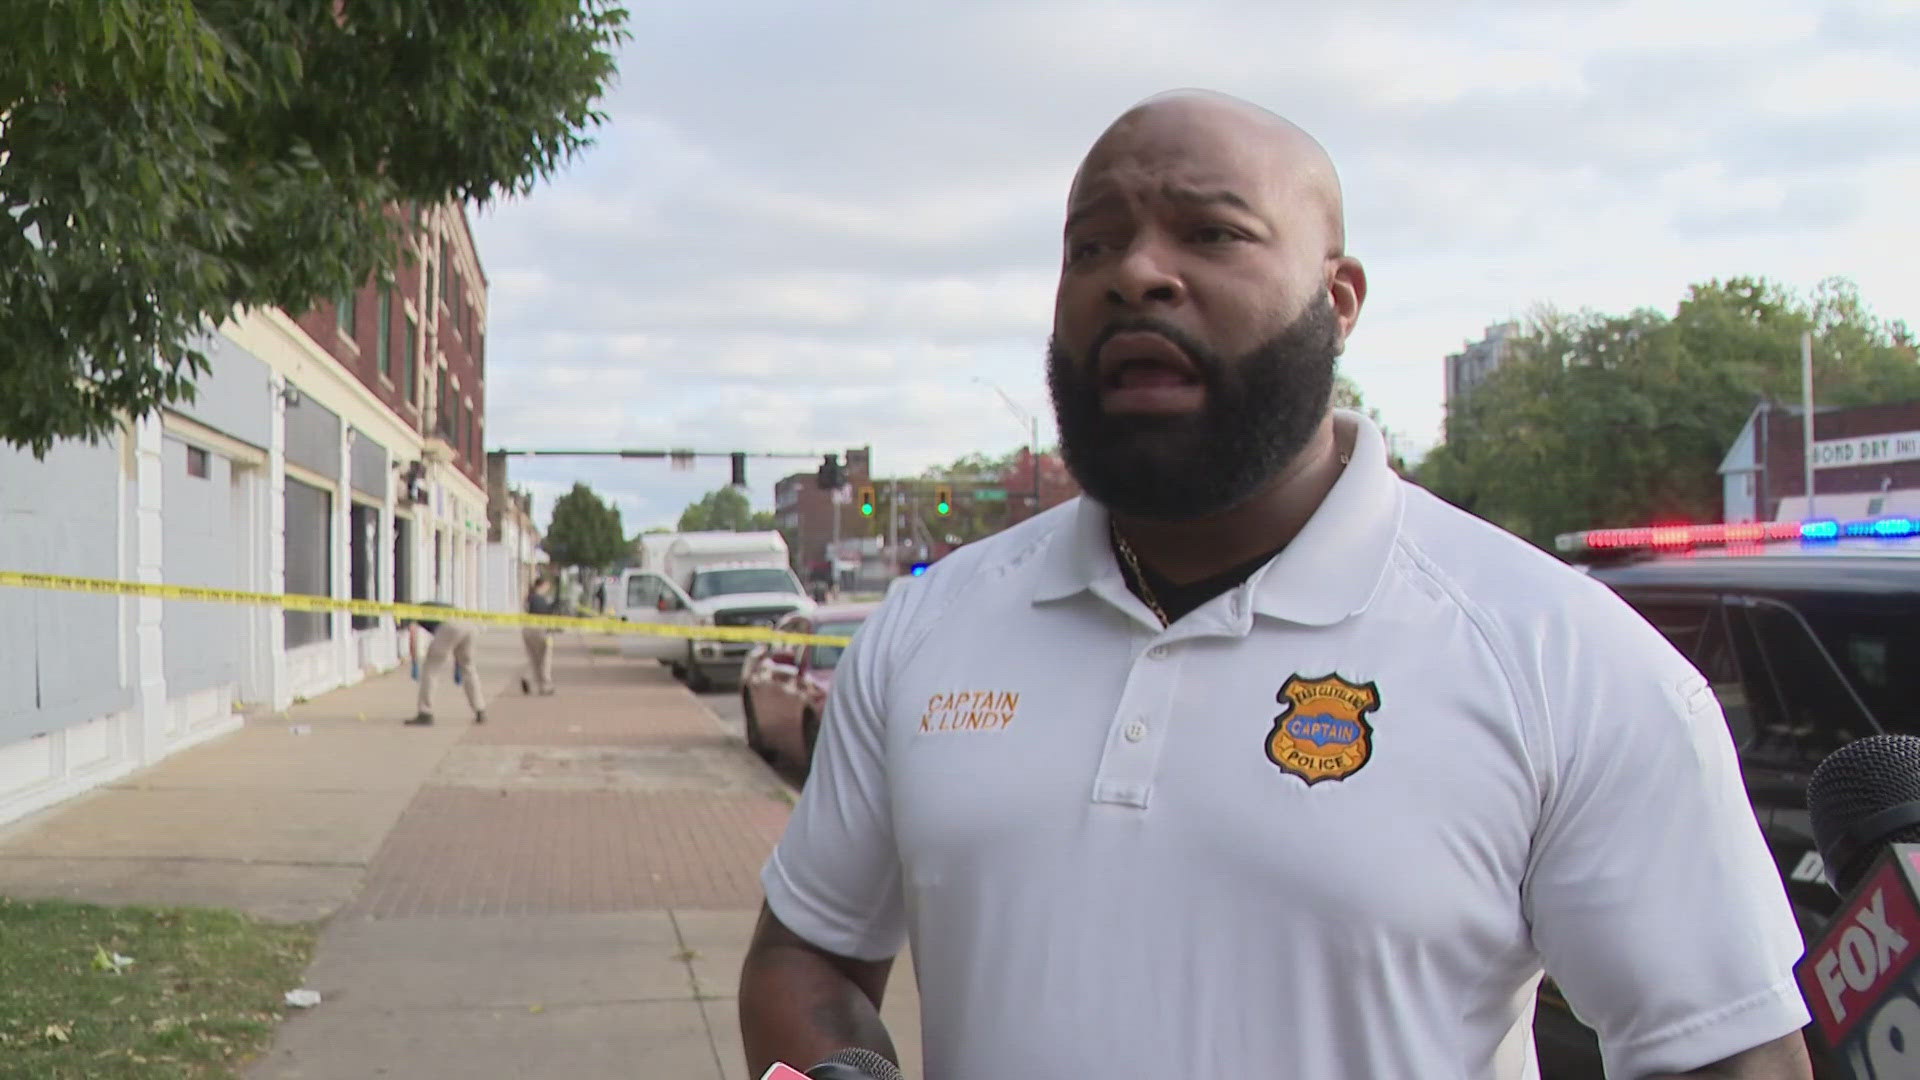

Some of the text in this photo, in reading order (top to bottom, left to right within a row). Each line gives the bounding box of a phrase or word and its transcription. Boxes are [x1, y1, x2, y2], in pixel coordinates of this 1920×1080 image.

[1861, 440, 1889, 459] DRY
[929, 691, 1019, 712] CAPTAIN
[939, 711, 1014, 730] LUNDY
[1291, 720, 1353, 740] CAPTAIN
[1288, 751, 1344, 770] POLICE
[1815, 887, 1910, 1025] FOX
